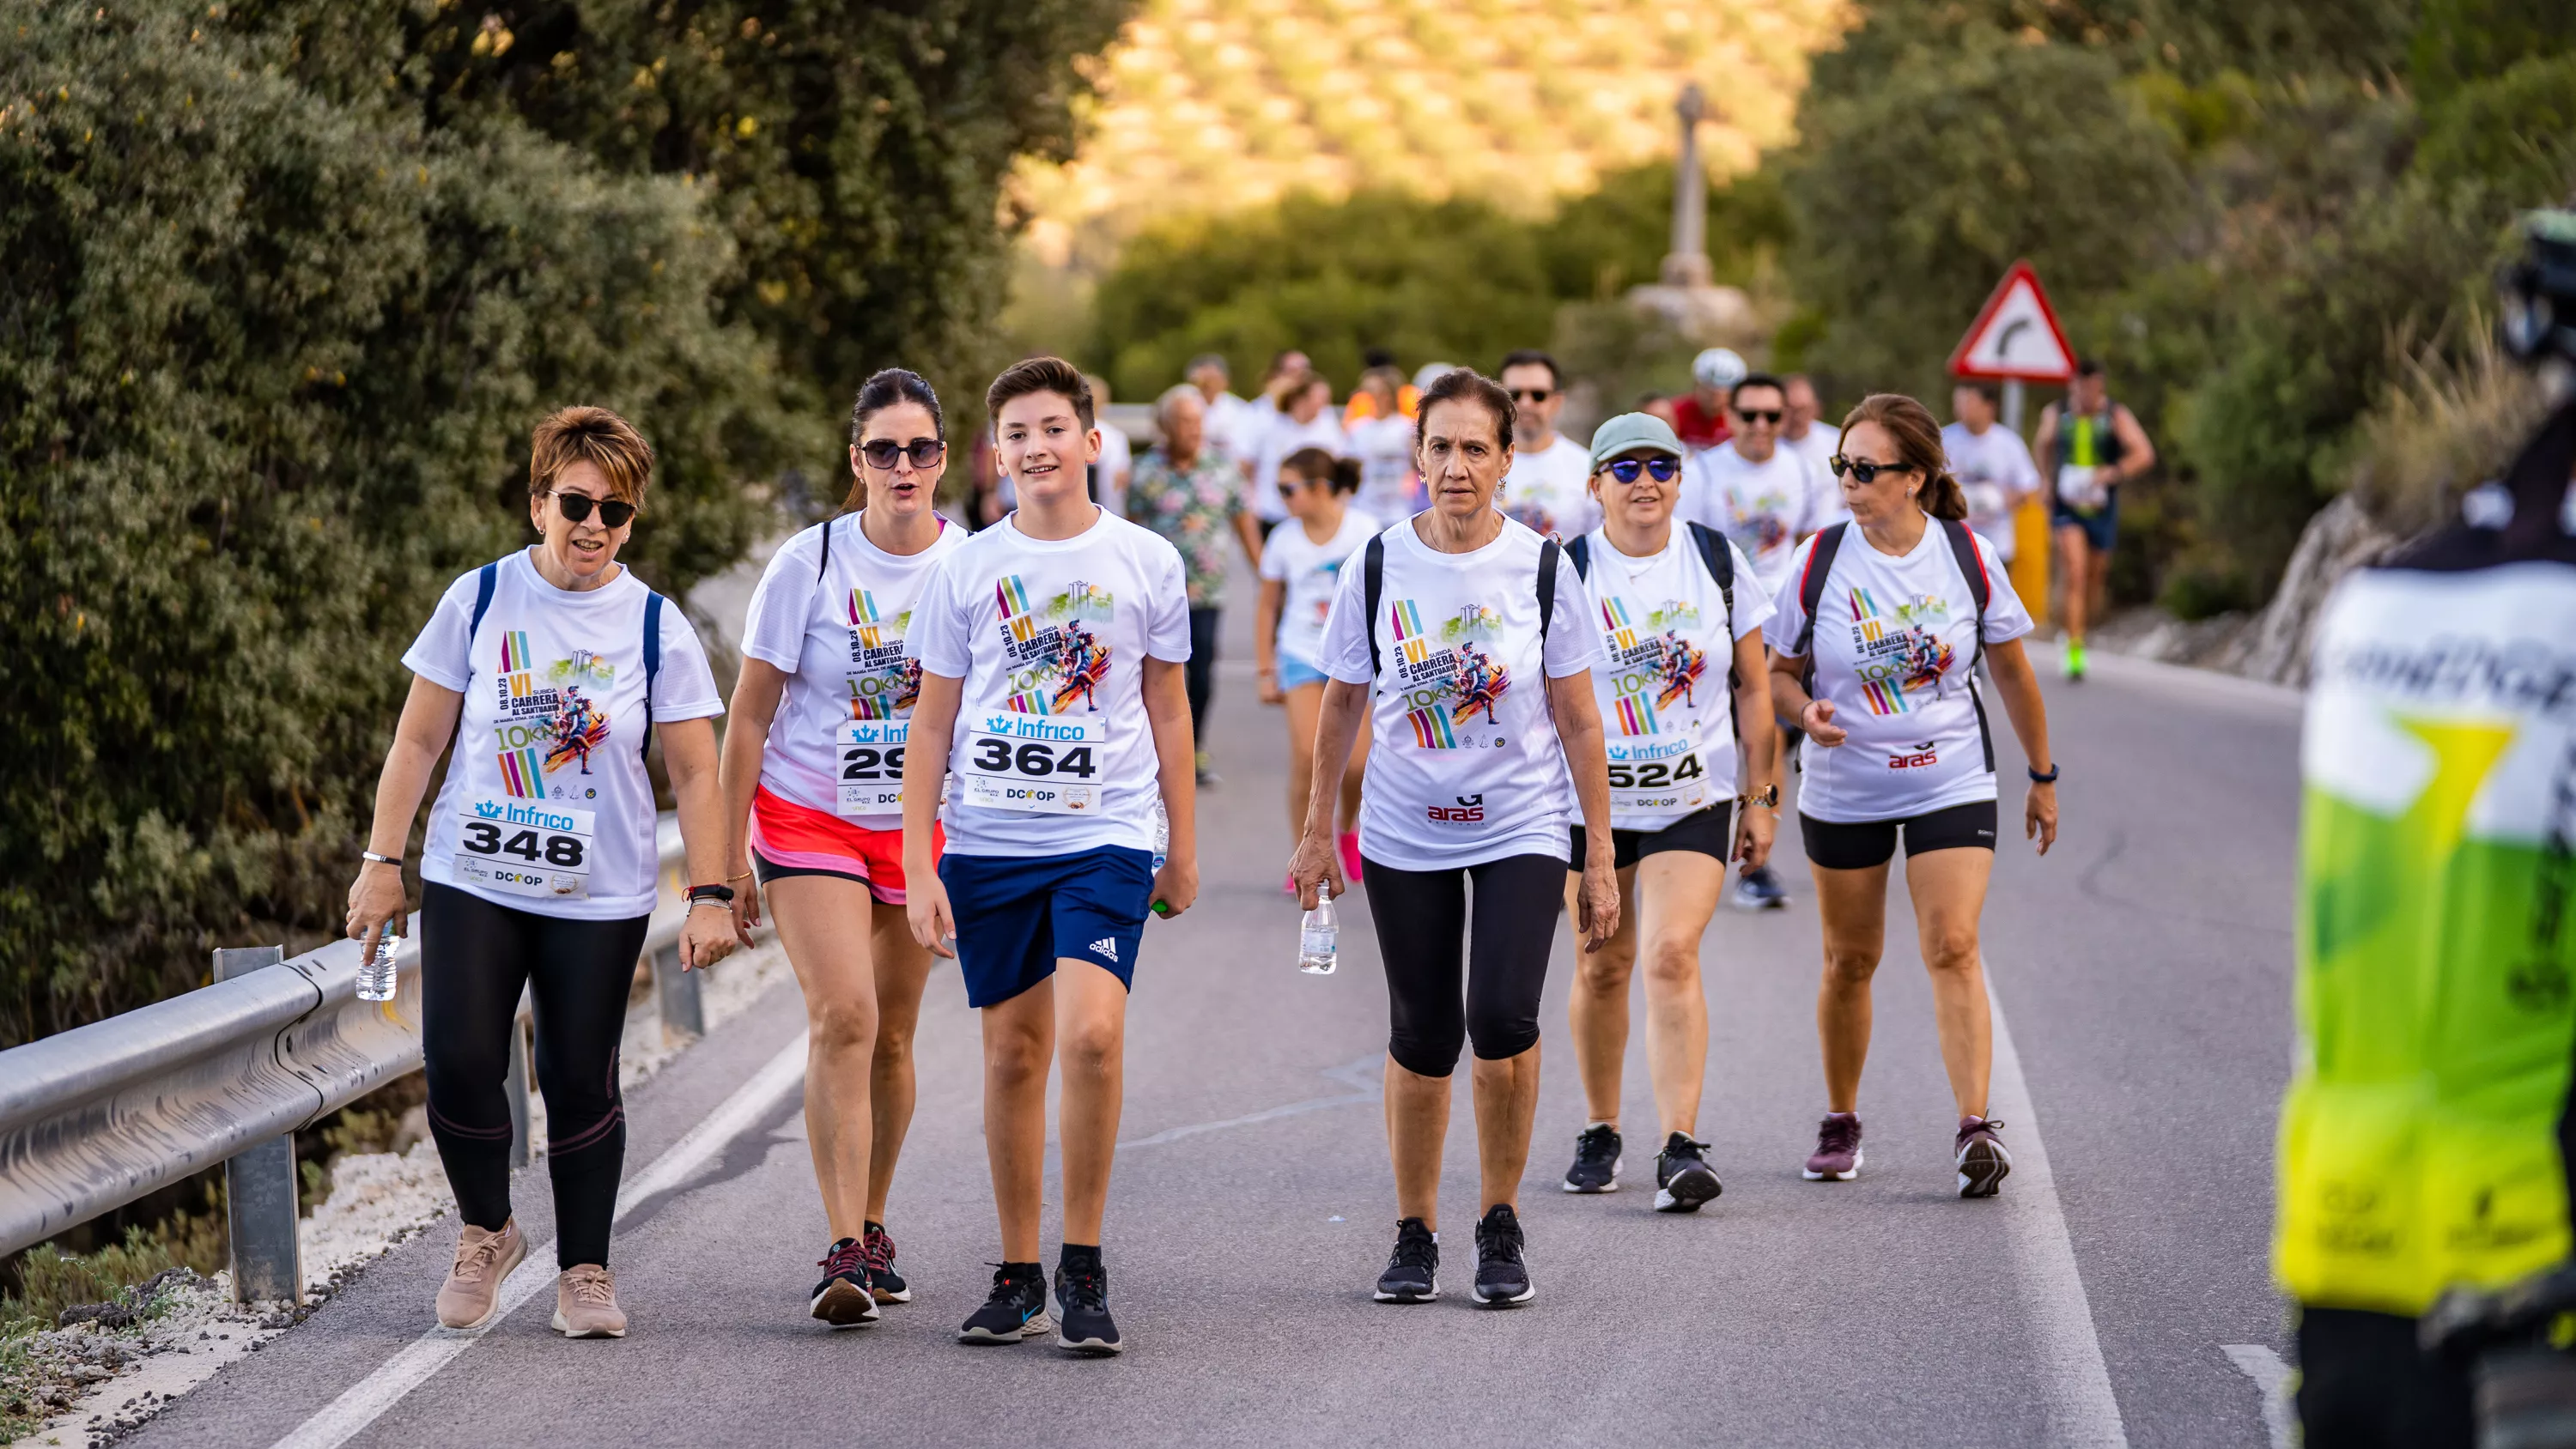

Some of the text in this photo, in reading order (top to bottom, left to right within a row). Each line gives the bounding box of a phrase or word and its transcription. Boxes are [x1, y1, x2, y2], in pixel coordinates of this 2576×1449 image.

[859, 626, 883, 649] VI
[1010, 615, 1036, 642] VI
[1036, 626, 1058, 636] SUBIDA
[1615, 628, 1637, 649] VI
[1862, 621, 1884, 641] VI
[849, 630, 861, 662] 08.10.23
[1000, 625, 1018, 658] 08.10.23
[1018, 631, 1062, 653] CARRERA
[1403, 638, 1428, 664] VI
[1622, 640, 1662, 658] CARRERA
[1867, 634, 1908, 651] CARRERA
[1394, 646, 1408, 678] 08.10.23
[1409, 653, 1457, 675] CARRERA
[1429, 649, 1452, 658] SUBIDA
[1421, 664, 1457, 680] SANTUARIO
[498, 678, 508, 710] 08.10.23
[509, 673, 532, 697] VI
[512, 694, 559, 708] CARRERA
[521, 704, 559, 715] SANTUARIO
[1017, 718, 1084, 740] Infrico
[974, 738, 1096, 779] 364
[1631, 738, 1688, 759] Infrico
[1889, 749, 1937, 768] aras
[843, 748, 905, 779] 29
[1608, 753, 1703, 788] 524
[507, 803, 574, 831] Infrico
[1428, 806, 1484, 822] aras
[463, 822, 584, 867] 348
[1090, 943, 1118, 962] adidas
